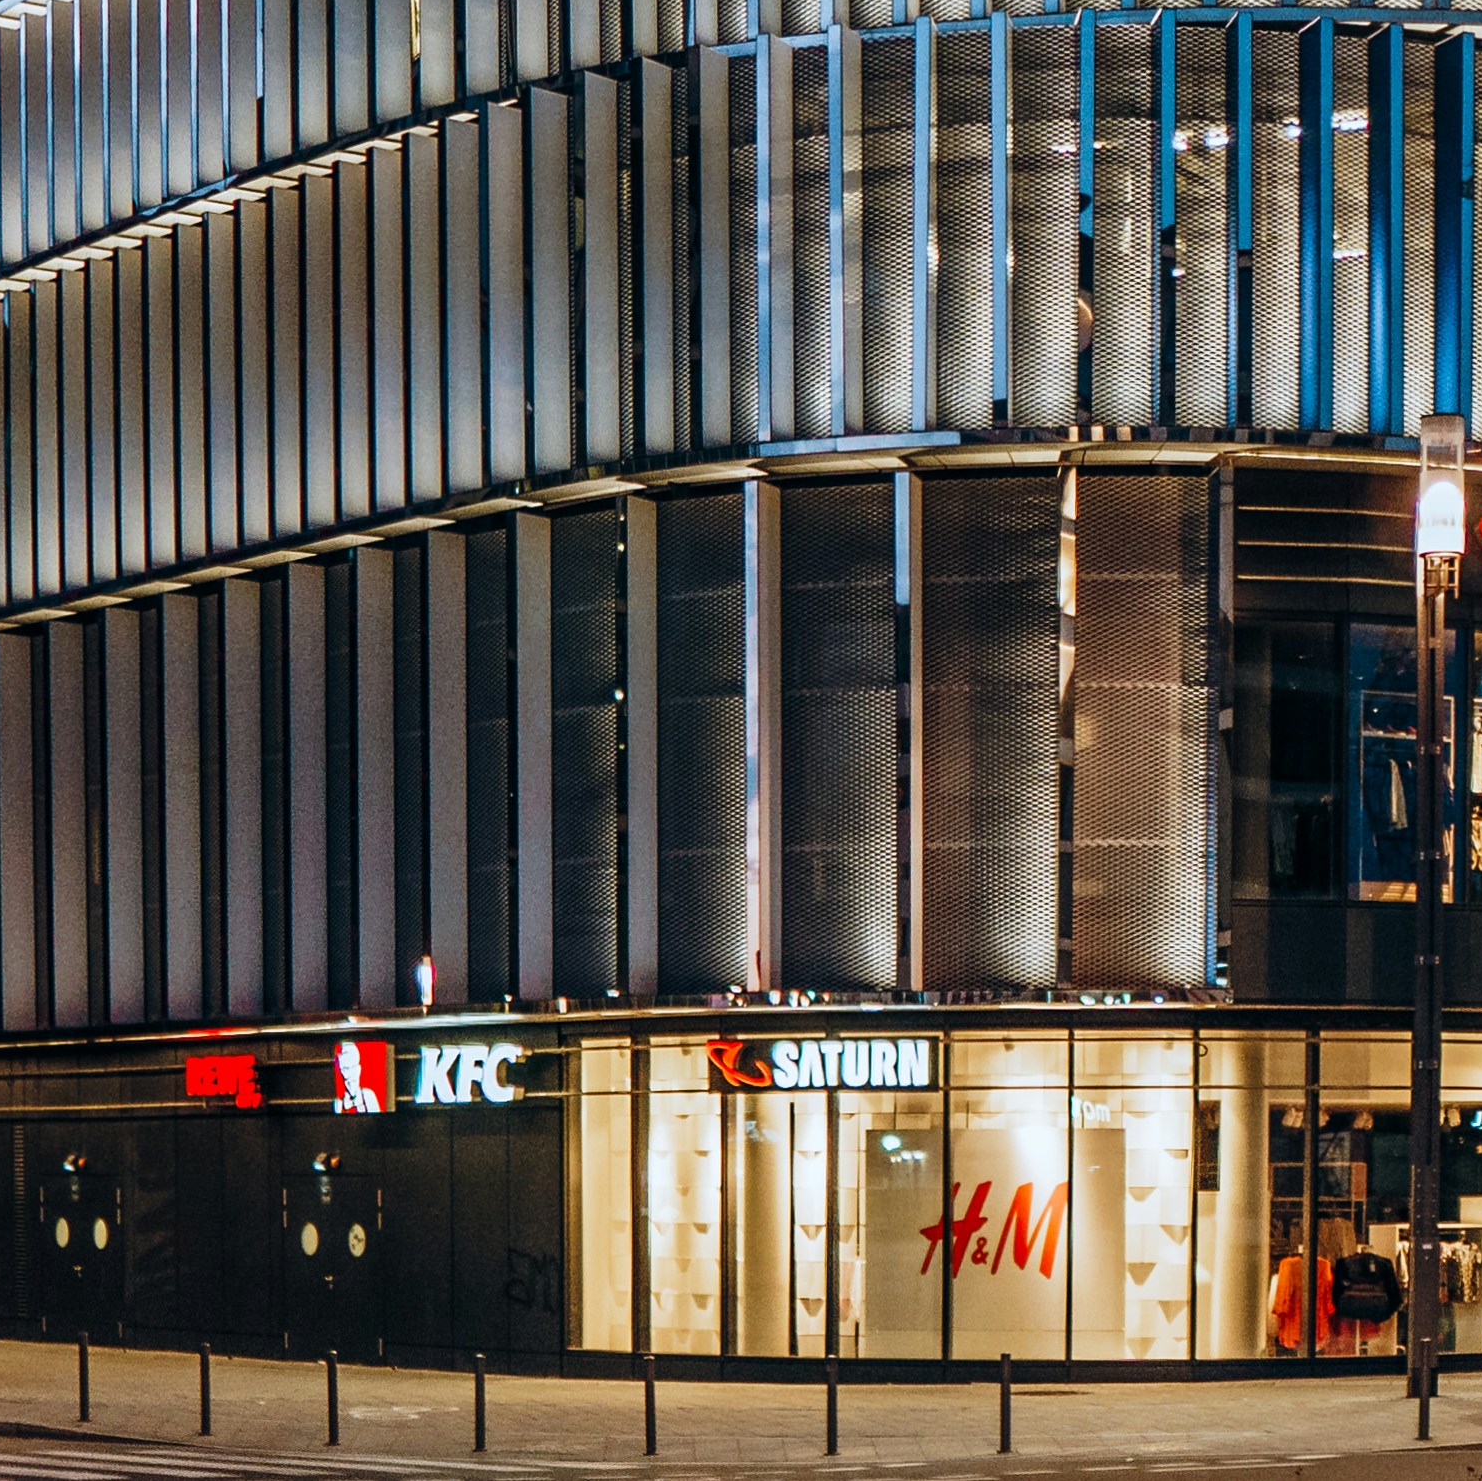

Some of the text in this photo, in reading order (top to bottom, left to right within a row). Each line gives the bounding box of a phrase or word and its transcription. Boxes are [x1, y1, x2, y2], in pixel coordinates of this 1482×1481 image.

[414, 1043, 520, 1105] KFC
[771, 1039, 930, 1089] SATURN
[918, 1180, 1069, 1280] H&M
